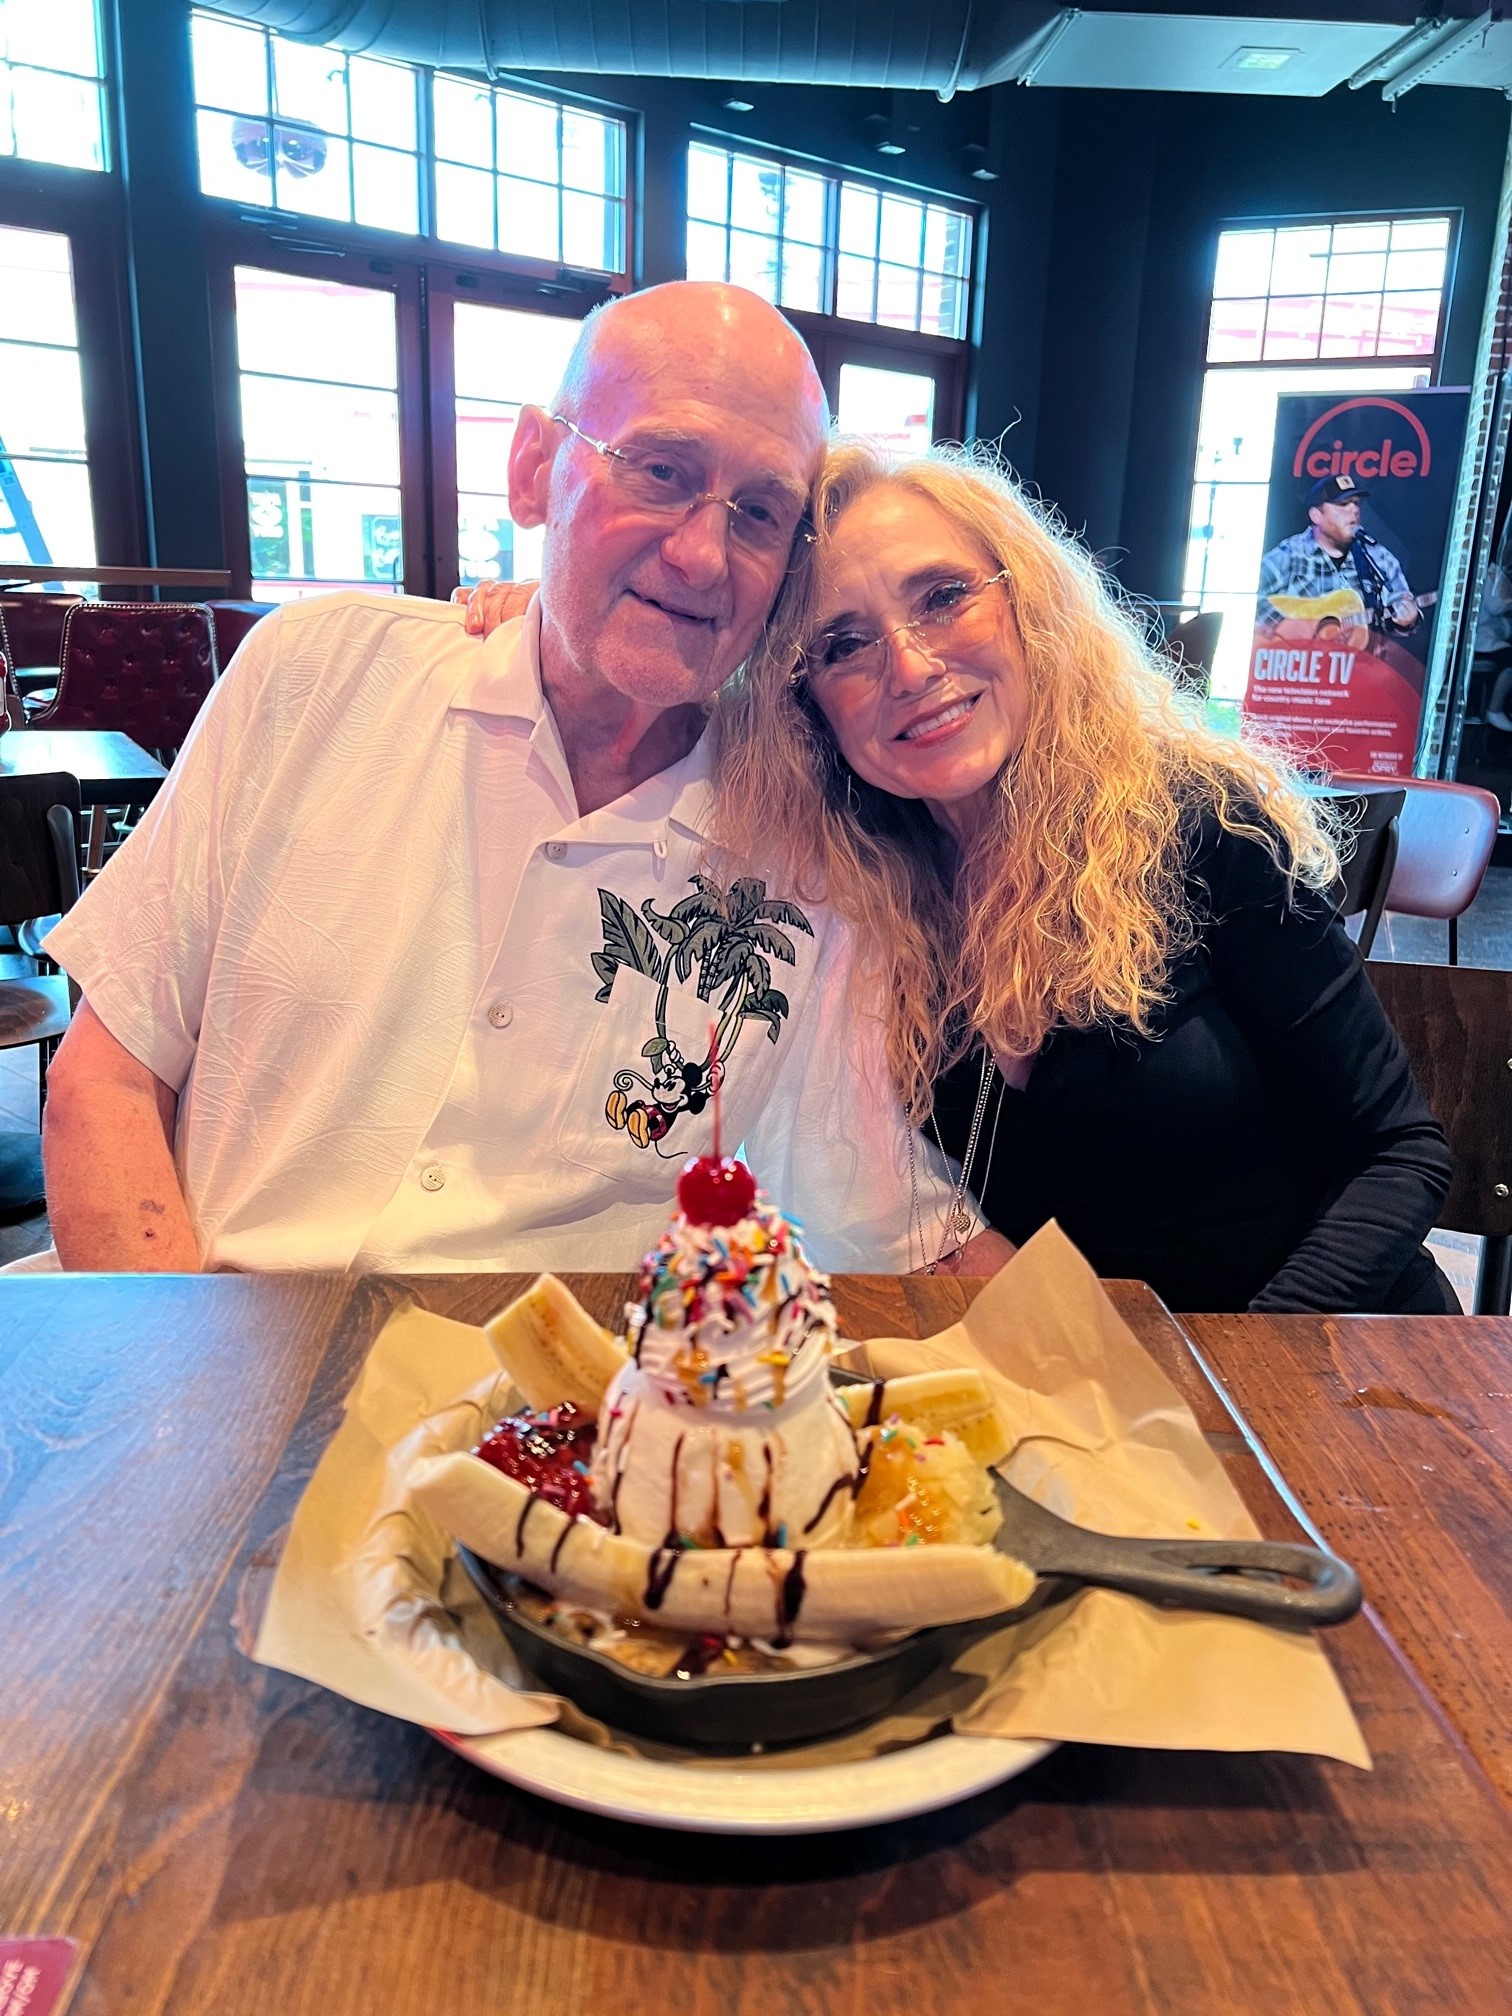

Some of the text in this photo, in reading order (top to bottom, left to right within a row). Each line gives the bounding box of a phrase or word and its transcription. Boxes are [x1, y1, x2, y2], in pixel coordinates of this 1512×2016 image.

[1306, 438, 1418, 478] circle
[1254, 648, 1356, 685] CIRCLE TV
